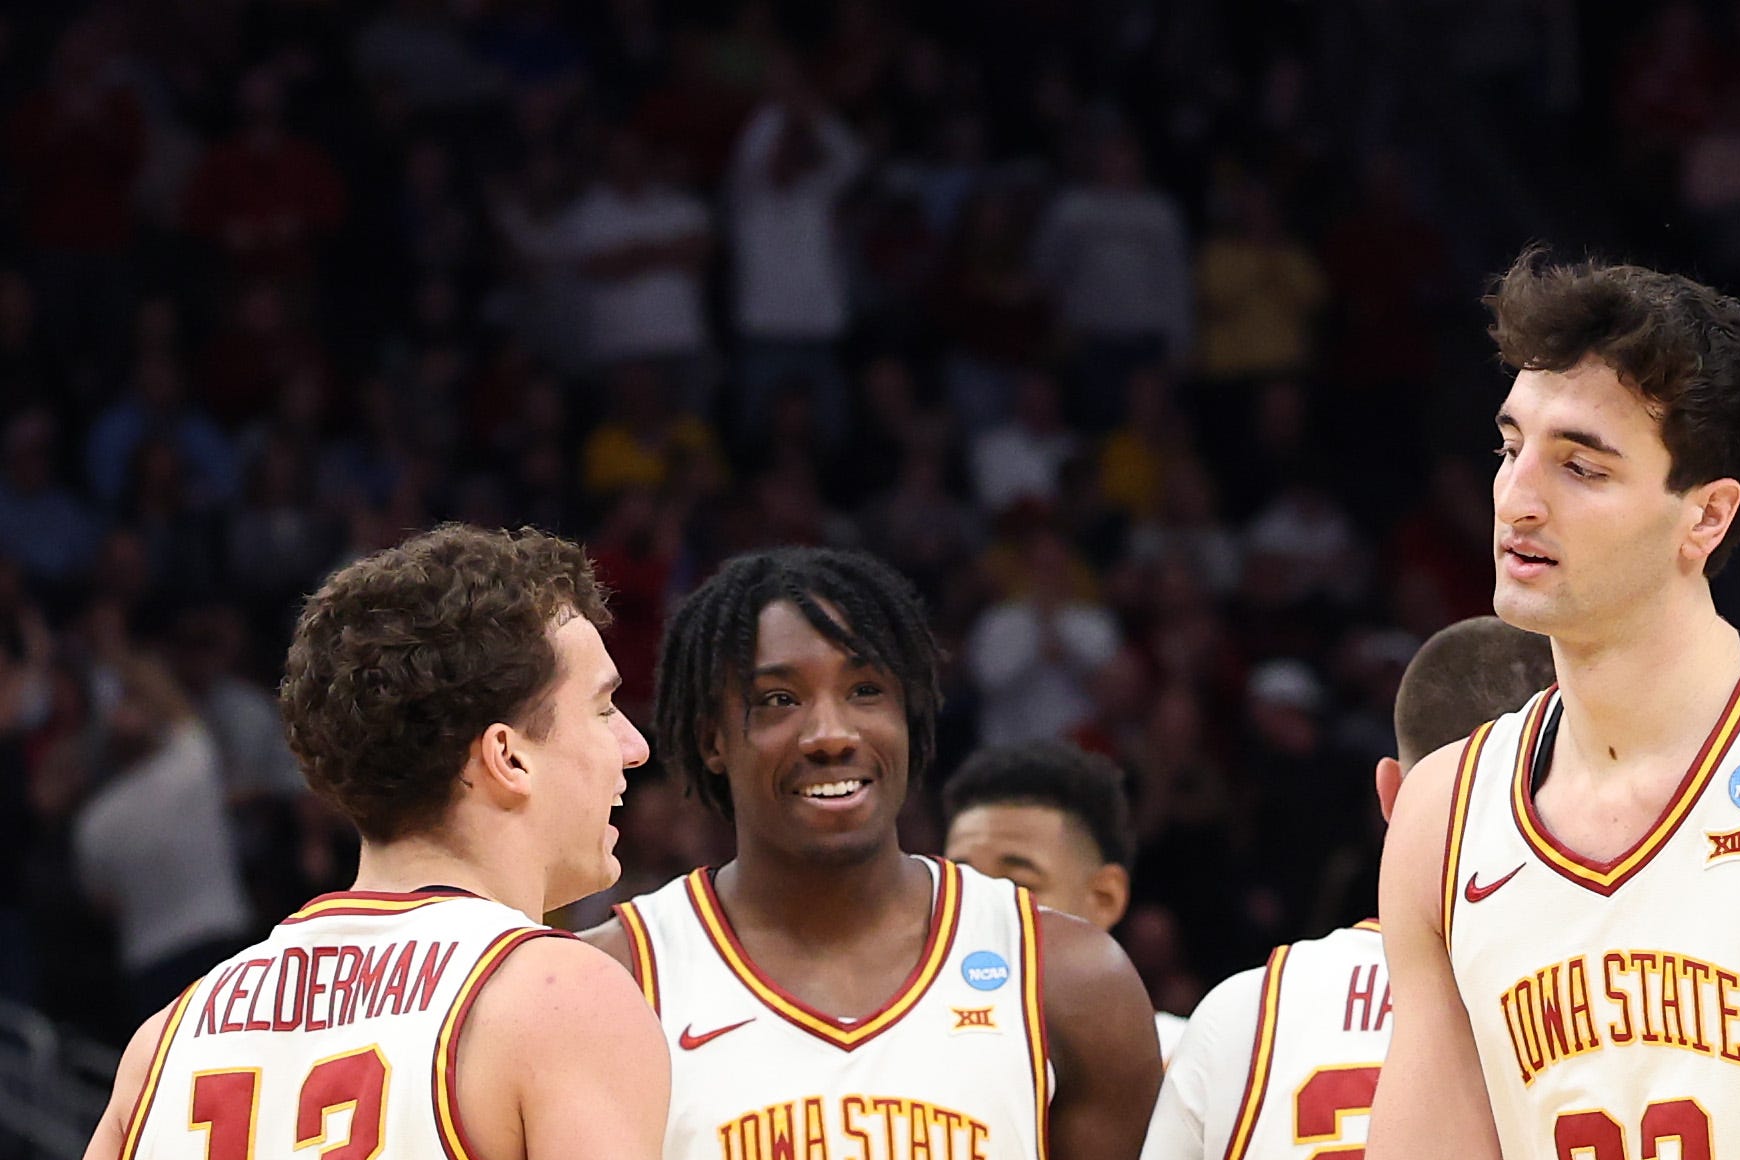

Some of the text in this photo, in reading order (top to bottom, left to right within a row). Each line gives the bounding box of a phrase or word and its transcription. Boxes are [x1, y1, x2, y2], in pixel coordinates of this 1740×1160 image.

[194, 940, 459, 1038] KELDERMAN
[967, 966, 1008, 981] NCAA
[1500, 953, 1601, 1087] IOWA
